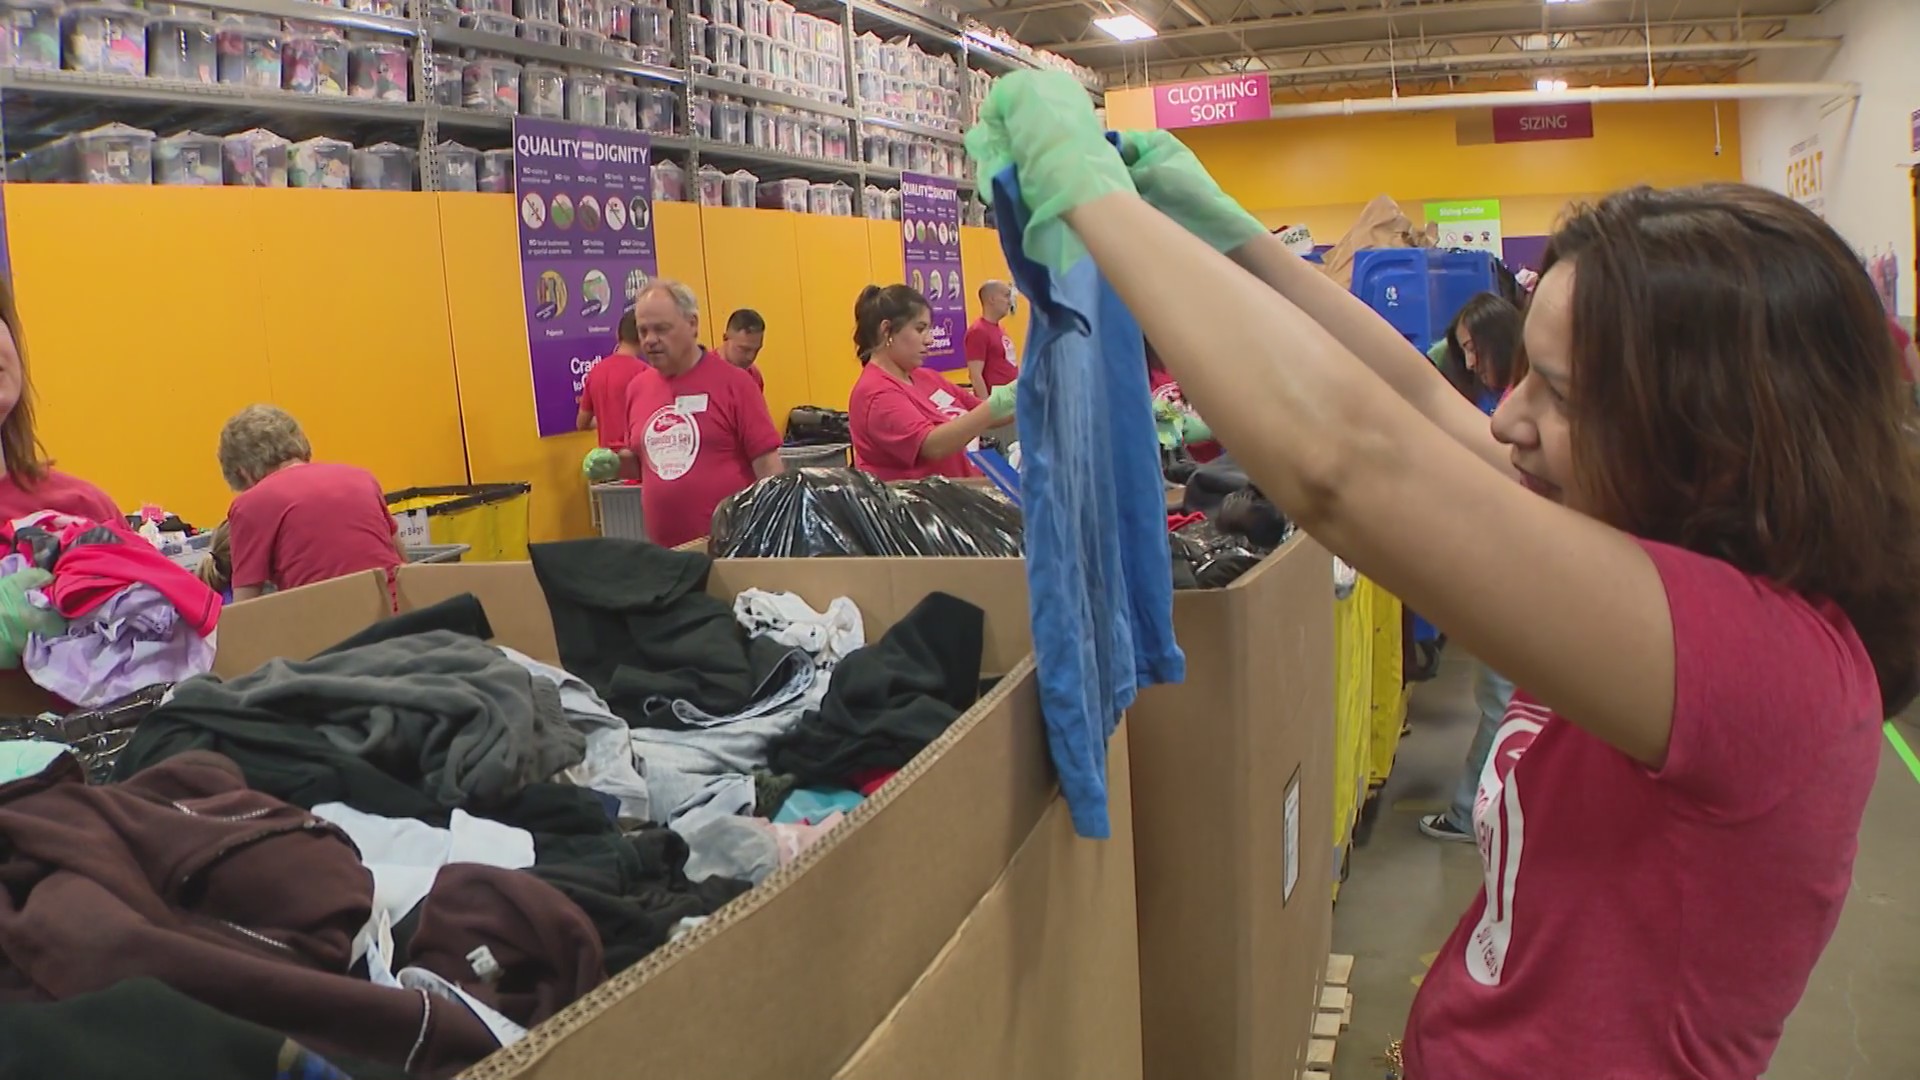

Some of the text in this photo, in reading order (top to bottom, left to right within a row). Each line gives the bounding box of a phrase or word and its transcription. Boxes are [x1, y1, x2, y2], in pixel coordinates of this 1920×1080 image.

[1167, 79, 1258, 105] CLOTHING
[1190, 101, 1238, 122] SORT
[1519, 114, 1568, 131] SIZING
[517, 134, 648, 164] QUALITY DIGNITY
[1786, 151, 1823, 199] GREAT
